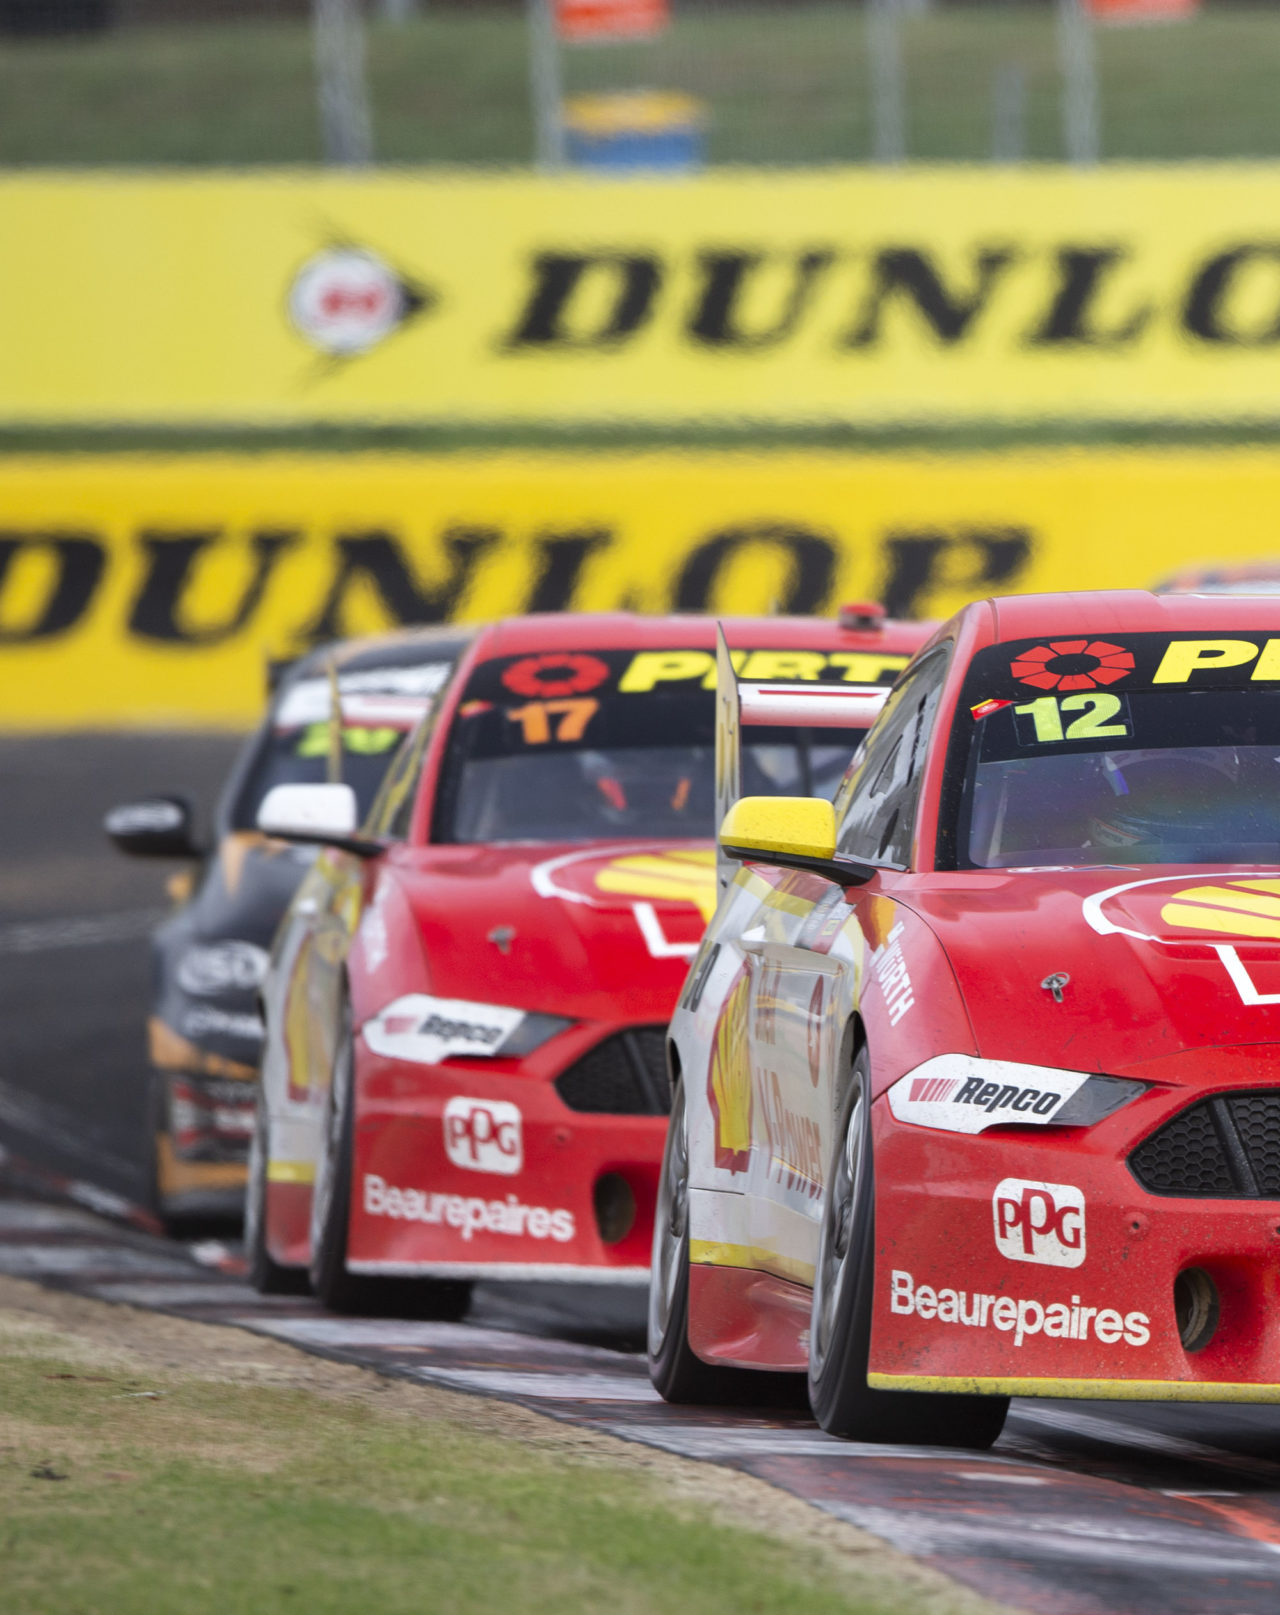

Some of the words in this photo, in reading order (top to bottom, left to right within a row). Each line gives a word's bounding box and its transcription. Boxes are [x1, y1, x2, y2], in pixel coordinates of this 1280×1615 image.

[507, 698, 598, 744] 17
[1014, 692, 1129, 742] 12
[953, 1077, 1061, 1115] Repco
[450, 1106, 518, 1162] PPG
[363, 1173, 576, 1242] Beaurepaires
[997, 1187, 1082, 1256] PPG
[891, 1269, 1150, 1347] Beaurepaires
